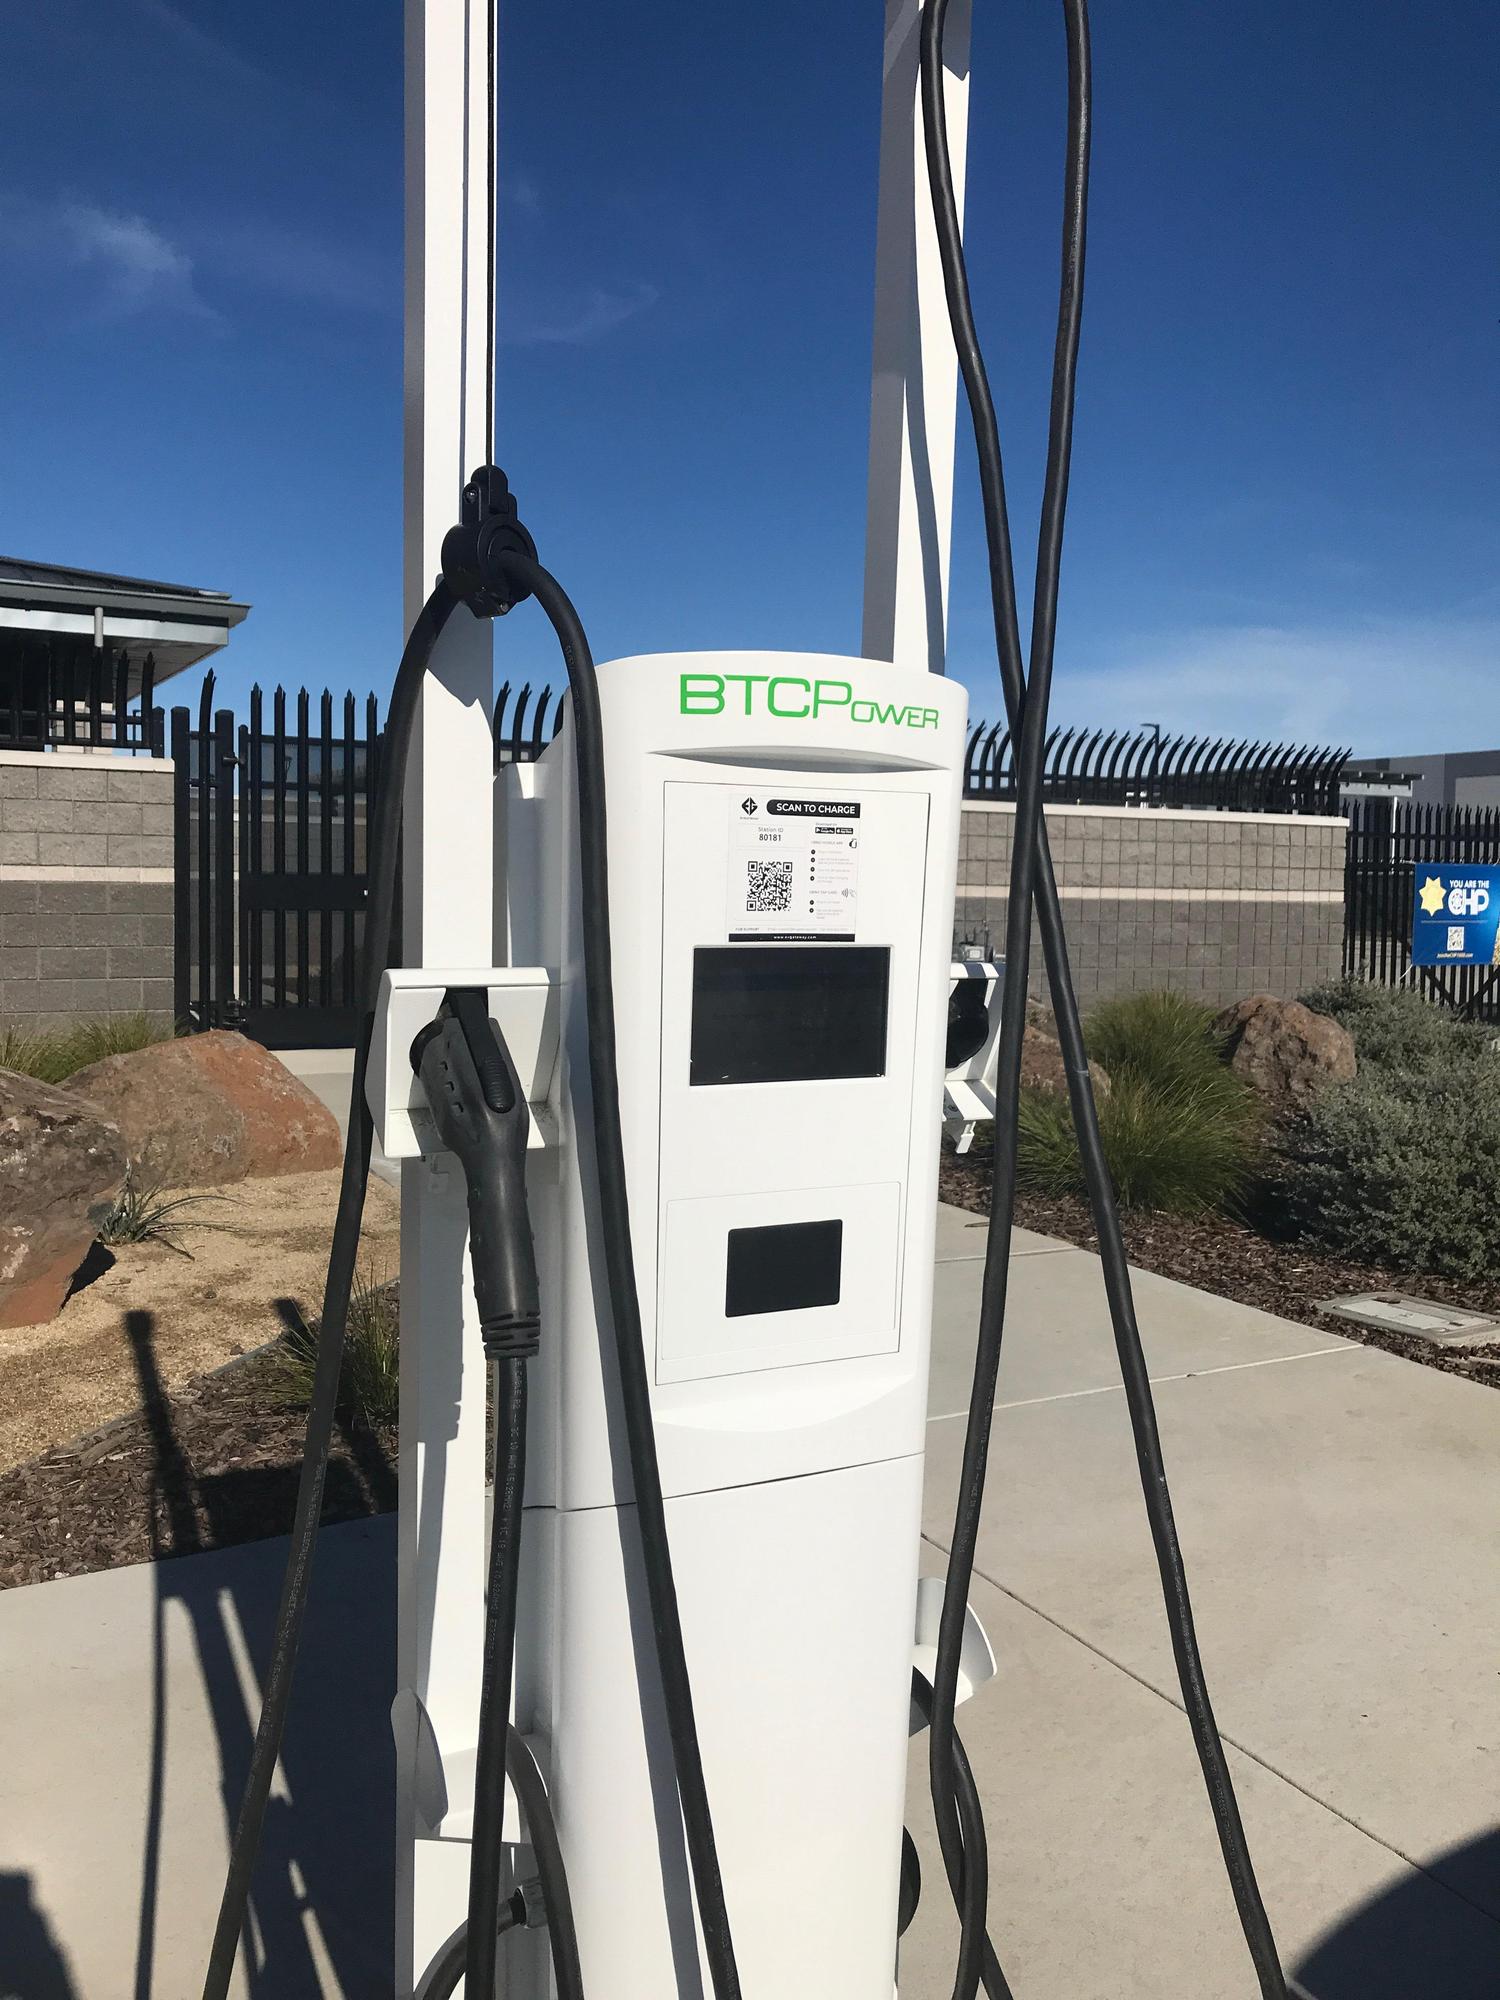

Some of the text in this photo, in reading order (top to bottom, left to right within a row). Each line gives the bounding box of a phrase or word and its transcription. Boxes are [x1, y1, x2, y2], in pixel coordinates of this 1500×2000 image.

[776, 803, 856, 815] SCAN TO CHARGE
[758, 833, 782, 841] 80181
[1449, 880, 1489, 888] YOU ARE THE
[1448, 888, 1489, 915] CHP
